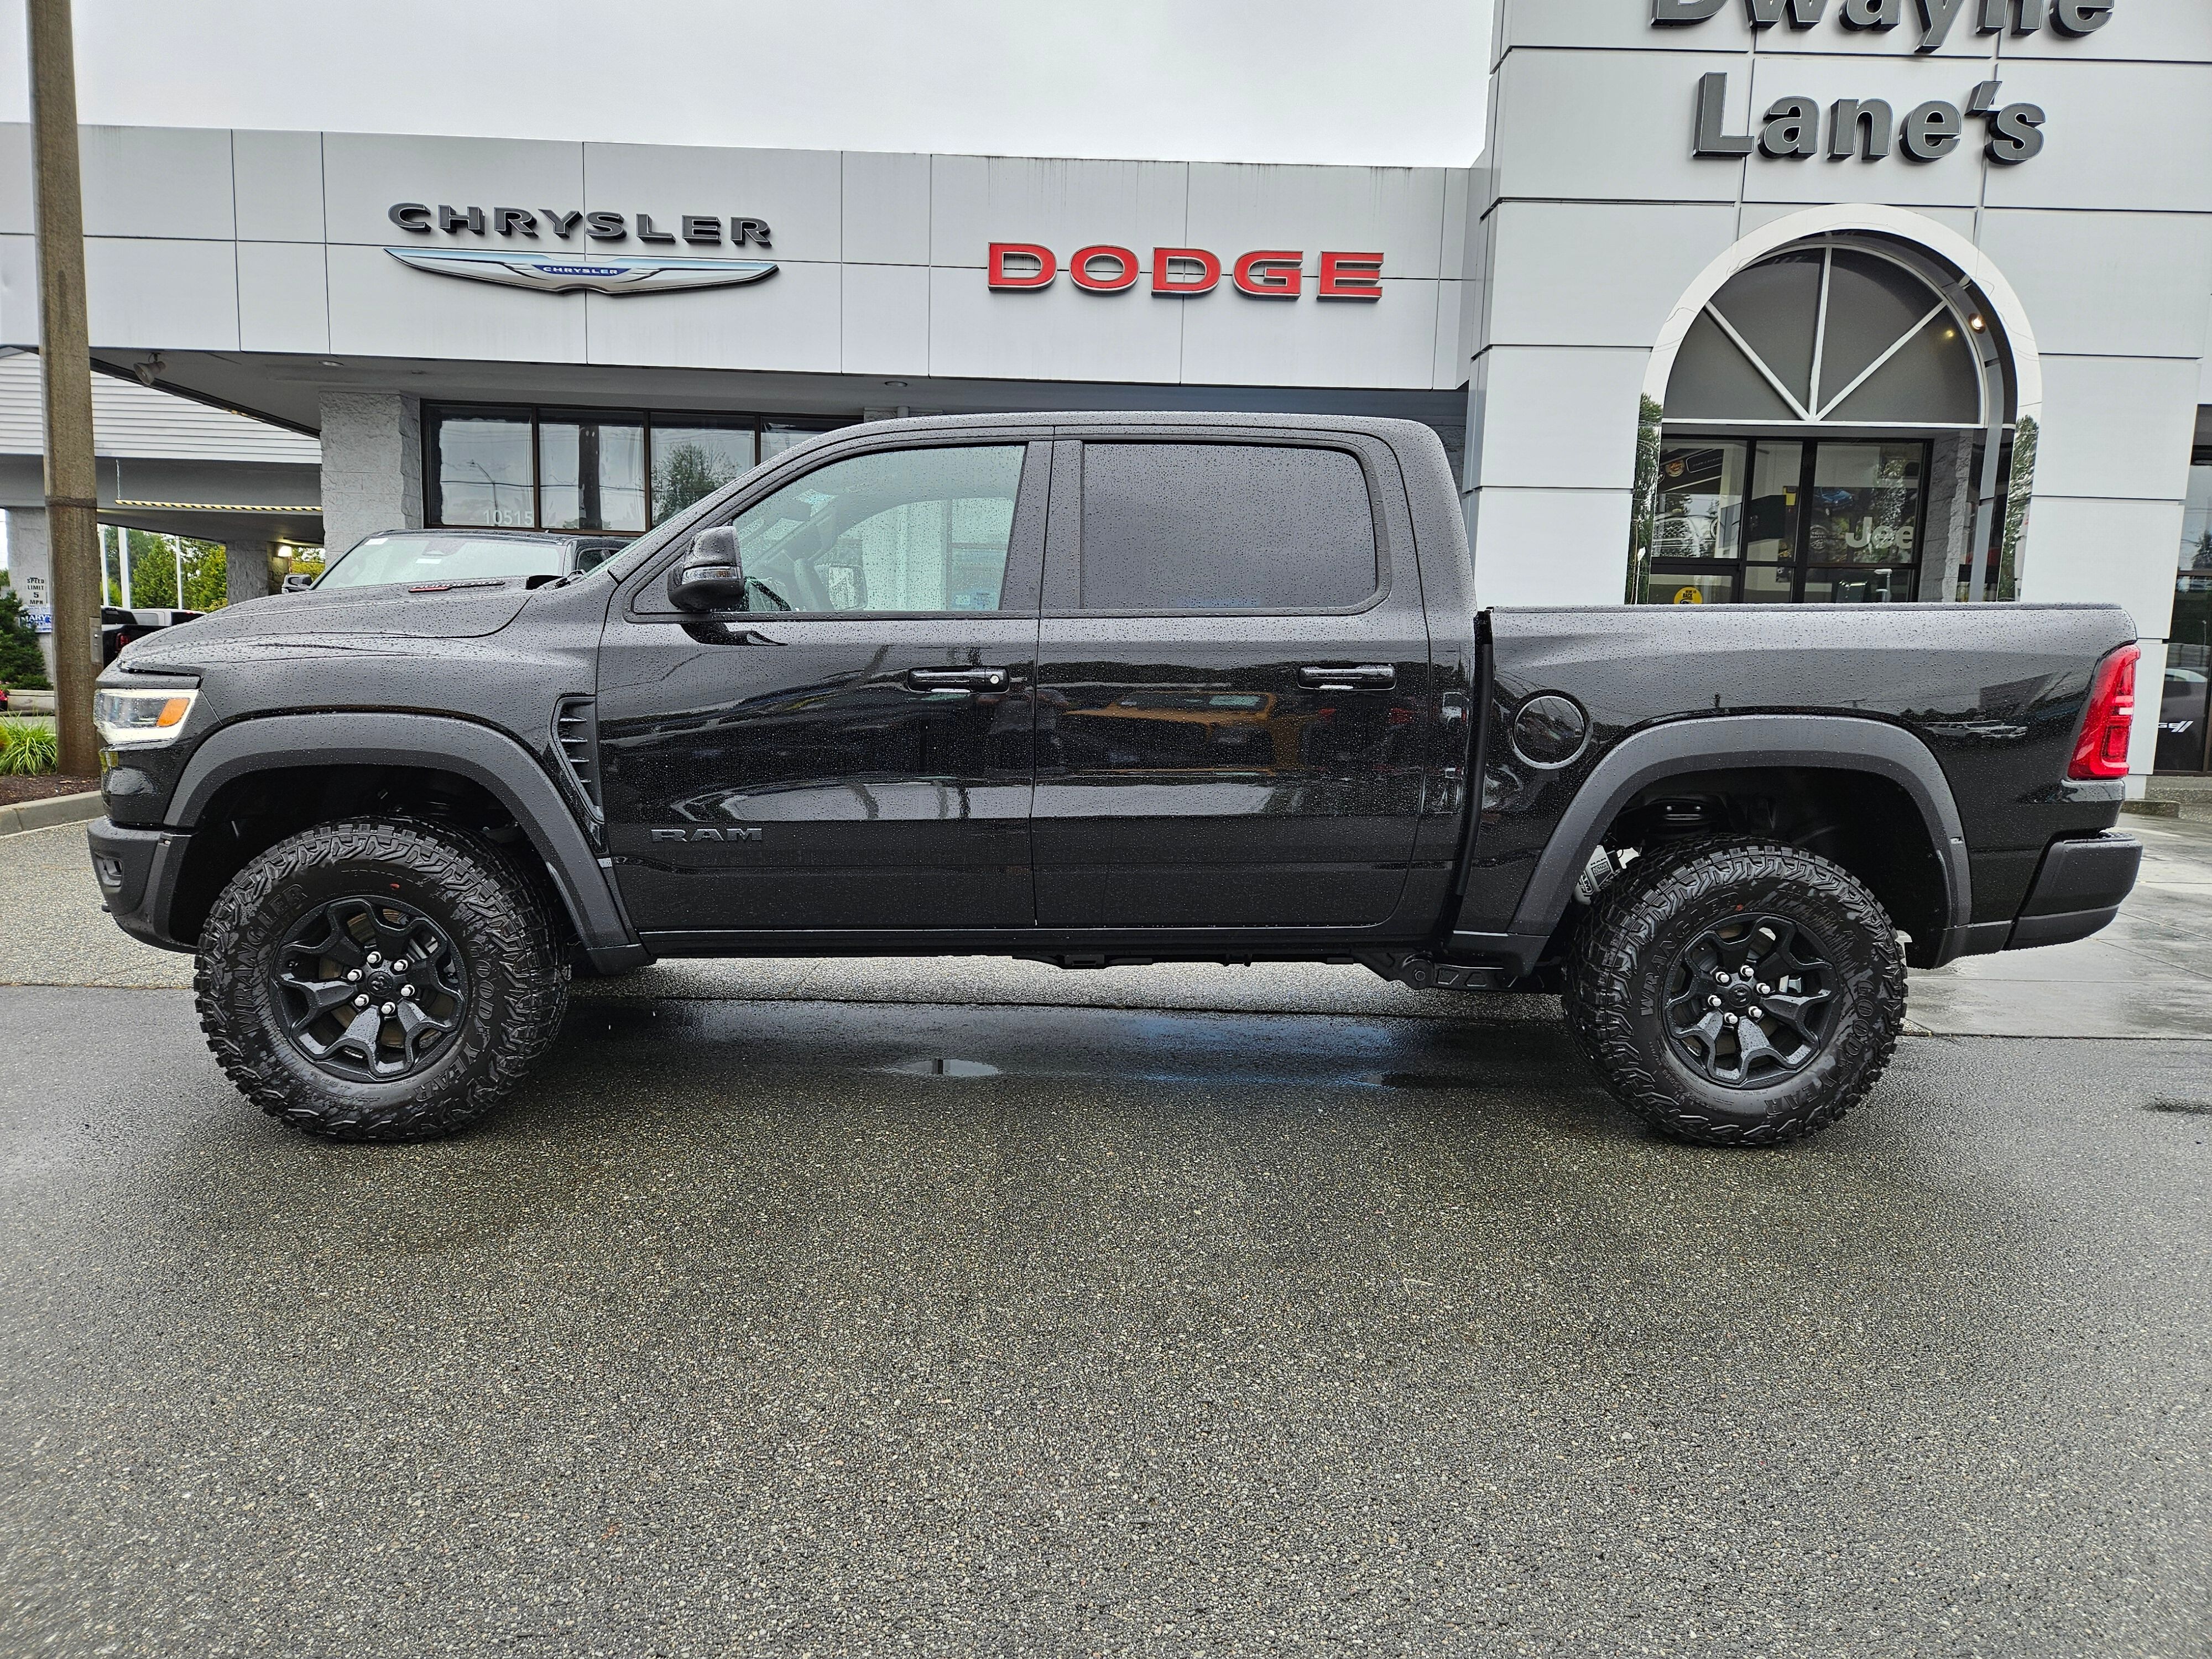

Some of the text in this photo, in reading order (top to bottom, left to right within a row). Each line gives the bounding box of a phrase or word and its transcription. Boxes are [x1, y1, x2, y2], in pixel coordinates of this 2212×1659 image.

[1651, 0, 2115, 54] yne
[1693, 72, 2046, 165] Lane's
[388, 202, 773, 248] CHRYSLER
[987, 242, 1385, 301] DODGE
[484, 509, 533, 526] 10515
[651, 828, 763, 842] RAM
[233, 884, 309, 1034] WRANGLER
[1640, 891, 1739, 1016] WRANGLER
